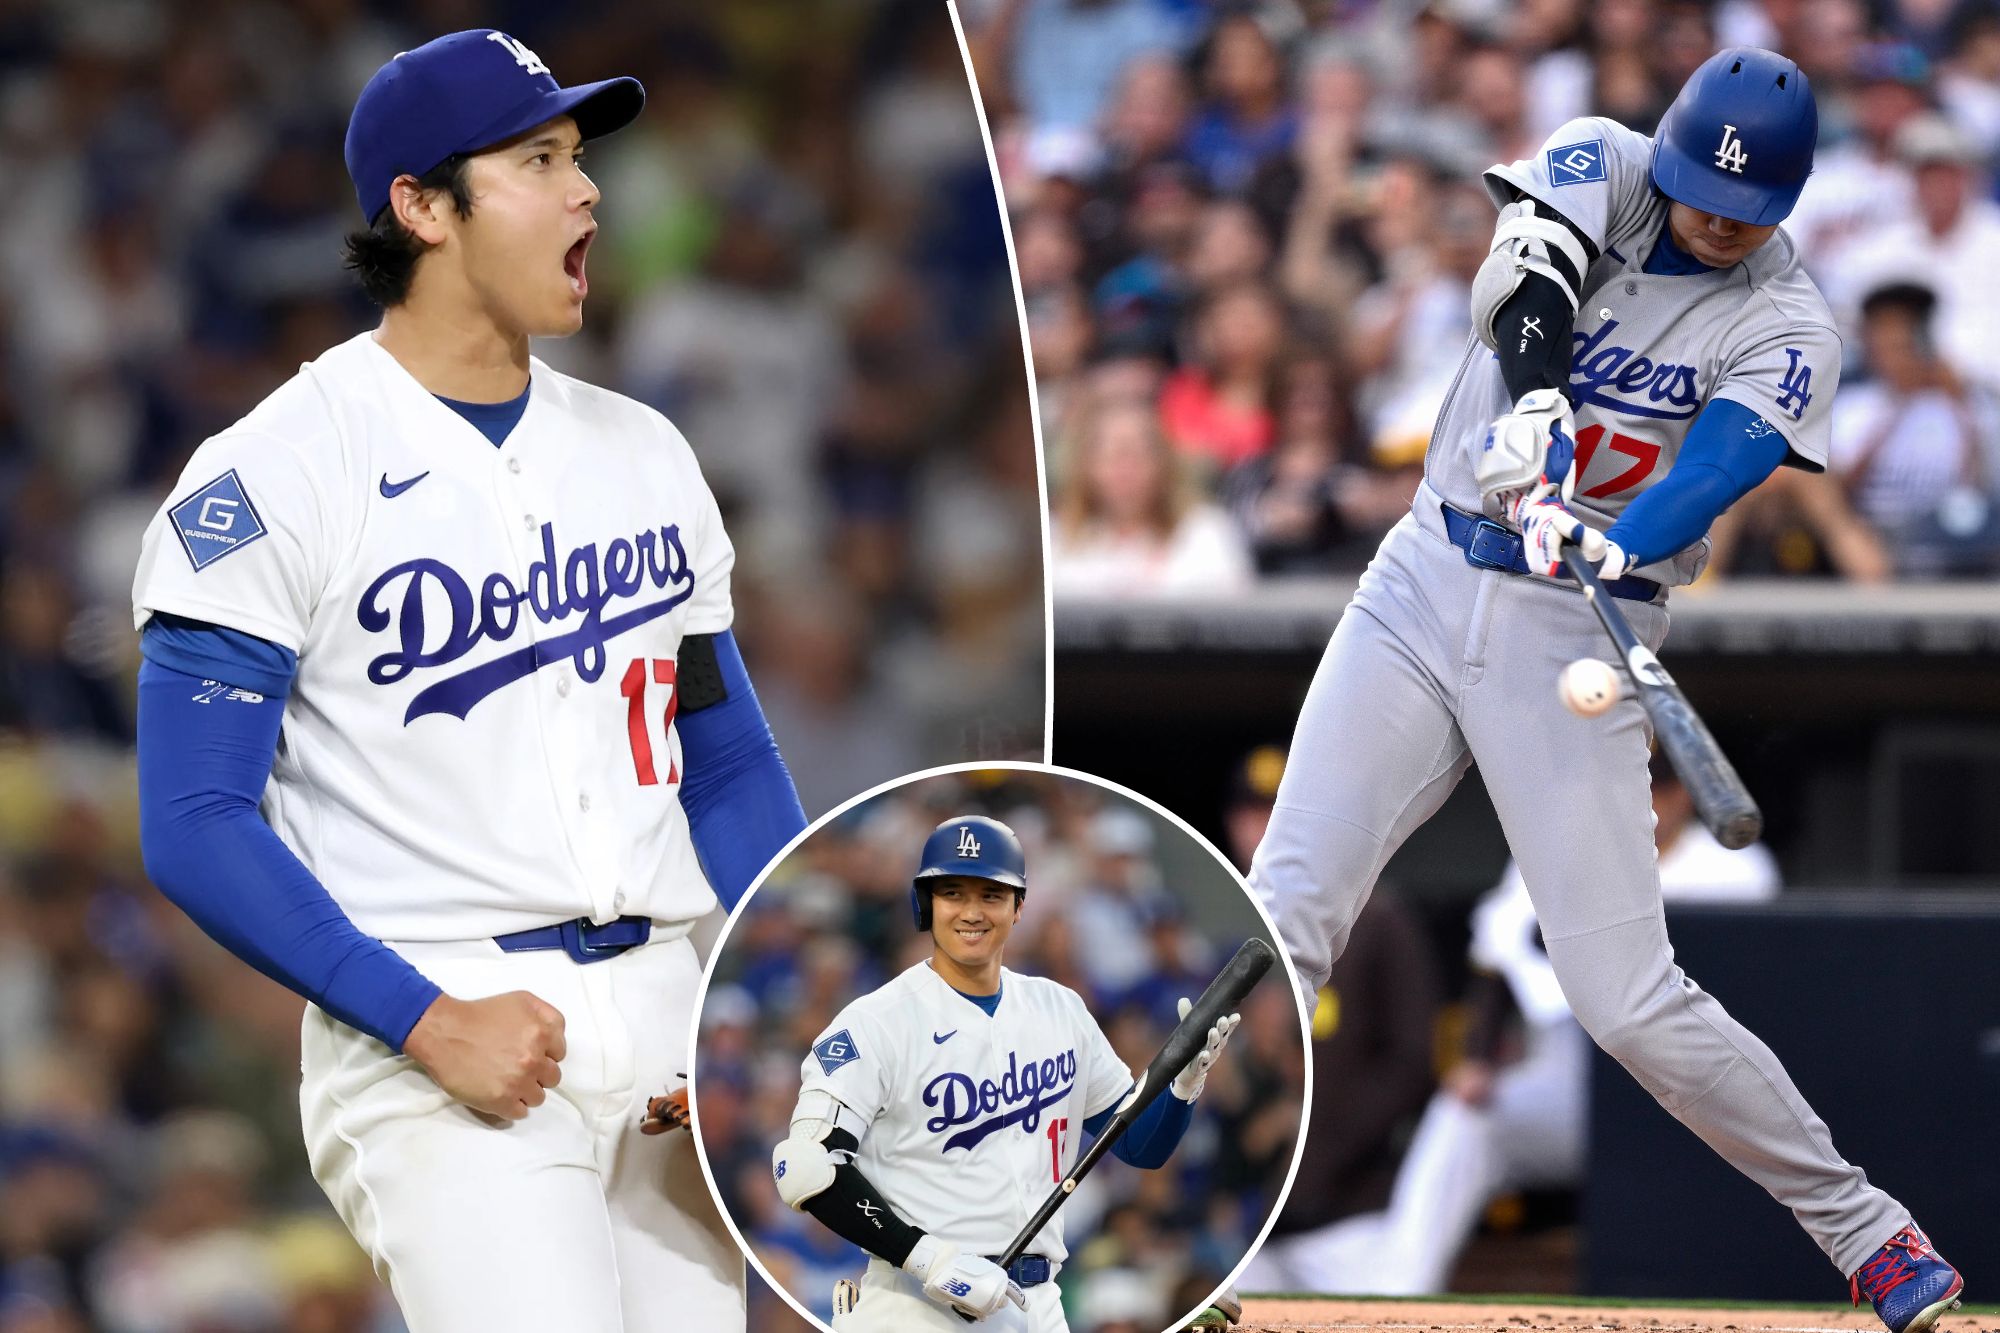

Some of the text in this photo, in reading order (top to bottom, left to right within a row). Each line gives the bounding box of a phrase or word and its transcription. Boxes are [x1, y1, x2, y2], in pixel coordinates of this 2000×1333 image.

[487, 31, 551, 75] LA
[1565, 149, 1597, 171] G
[1715, 125, 1748, 174] LA
[1570, 319, 1701, 420] dgers
[1775, 347, 1813, 421] LA
[1574, 423, 1662, 499] 17
[198, 496, 239, 531] G
[357, 522, 695, 685] Dodgers
[957, 826, 981, 858] LA
[828, 1041, 848, 1057] G
[922, 1048, 1077, 1134] Dodgers
